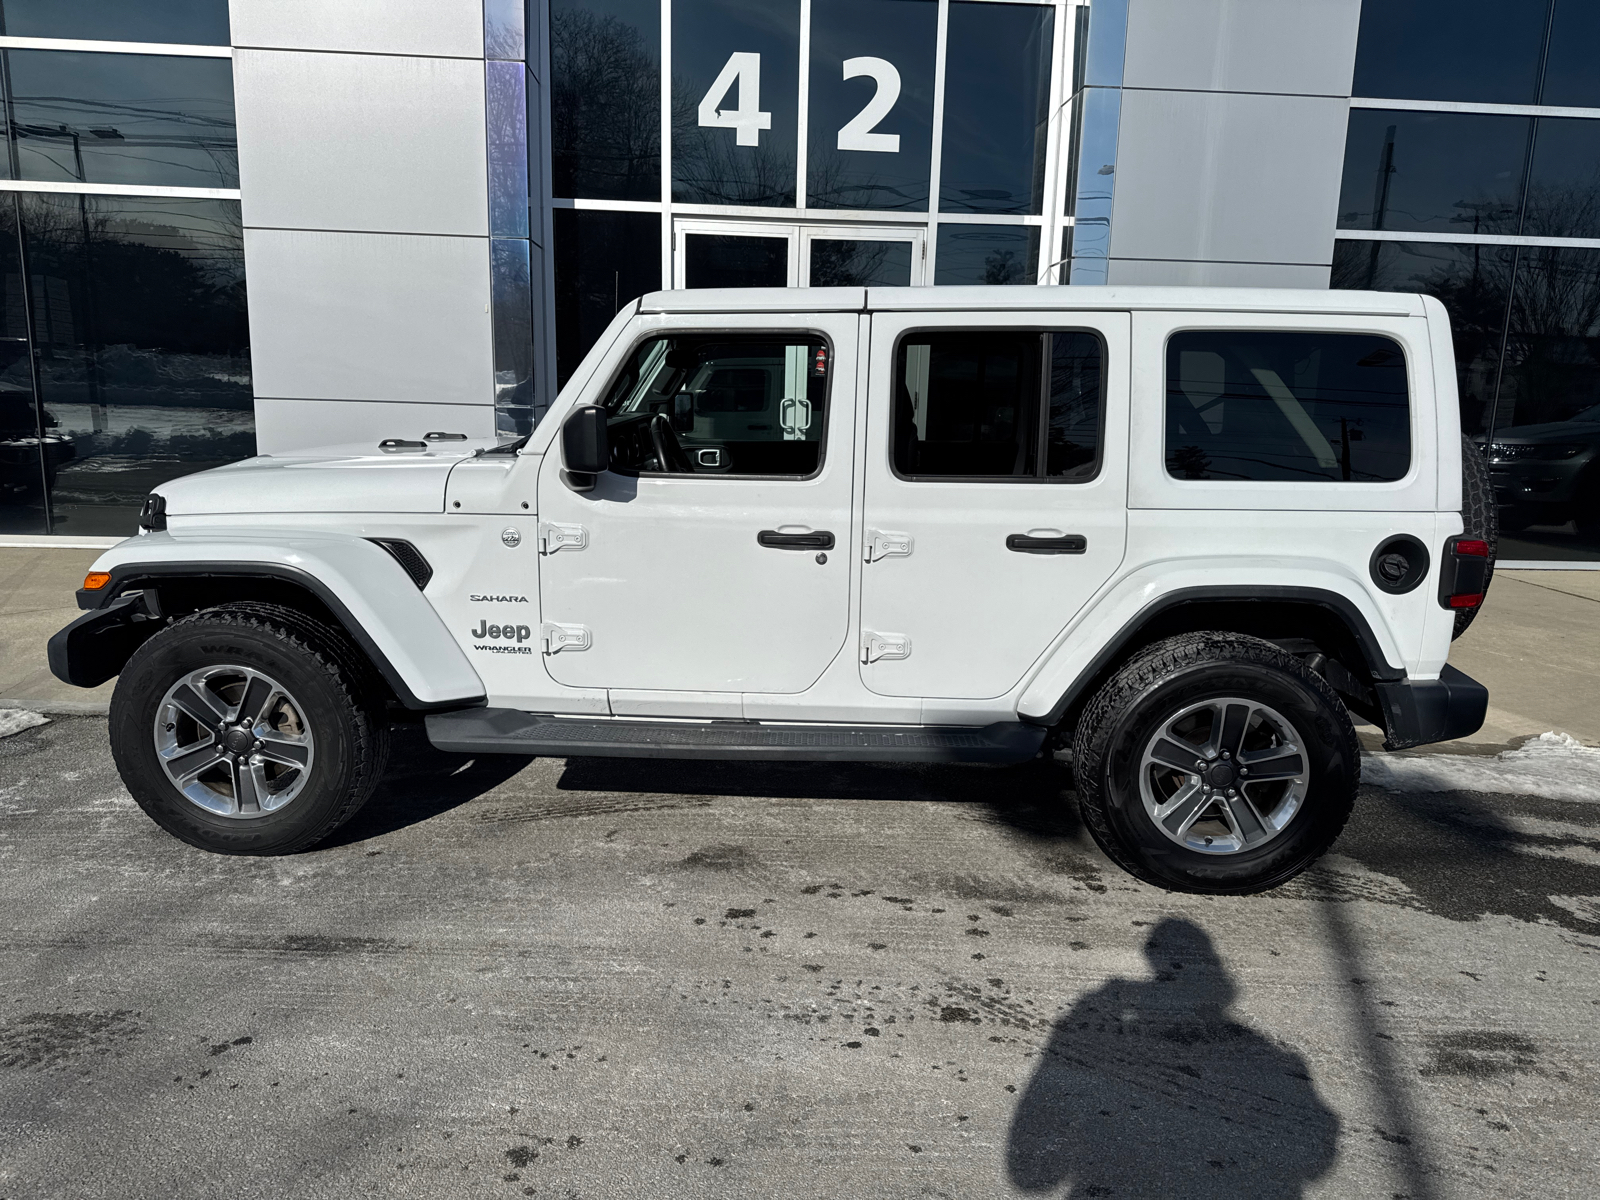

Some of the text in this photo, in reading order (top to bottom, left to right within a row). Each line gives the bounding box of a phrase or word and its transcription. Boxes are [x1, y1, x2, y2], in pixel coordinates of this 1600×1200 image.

[469, 594, 529, 603] SAHARA
[471, 619, 531, 643] Jeep
[473, 644, 532, 652] WRANGLER
